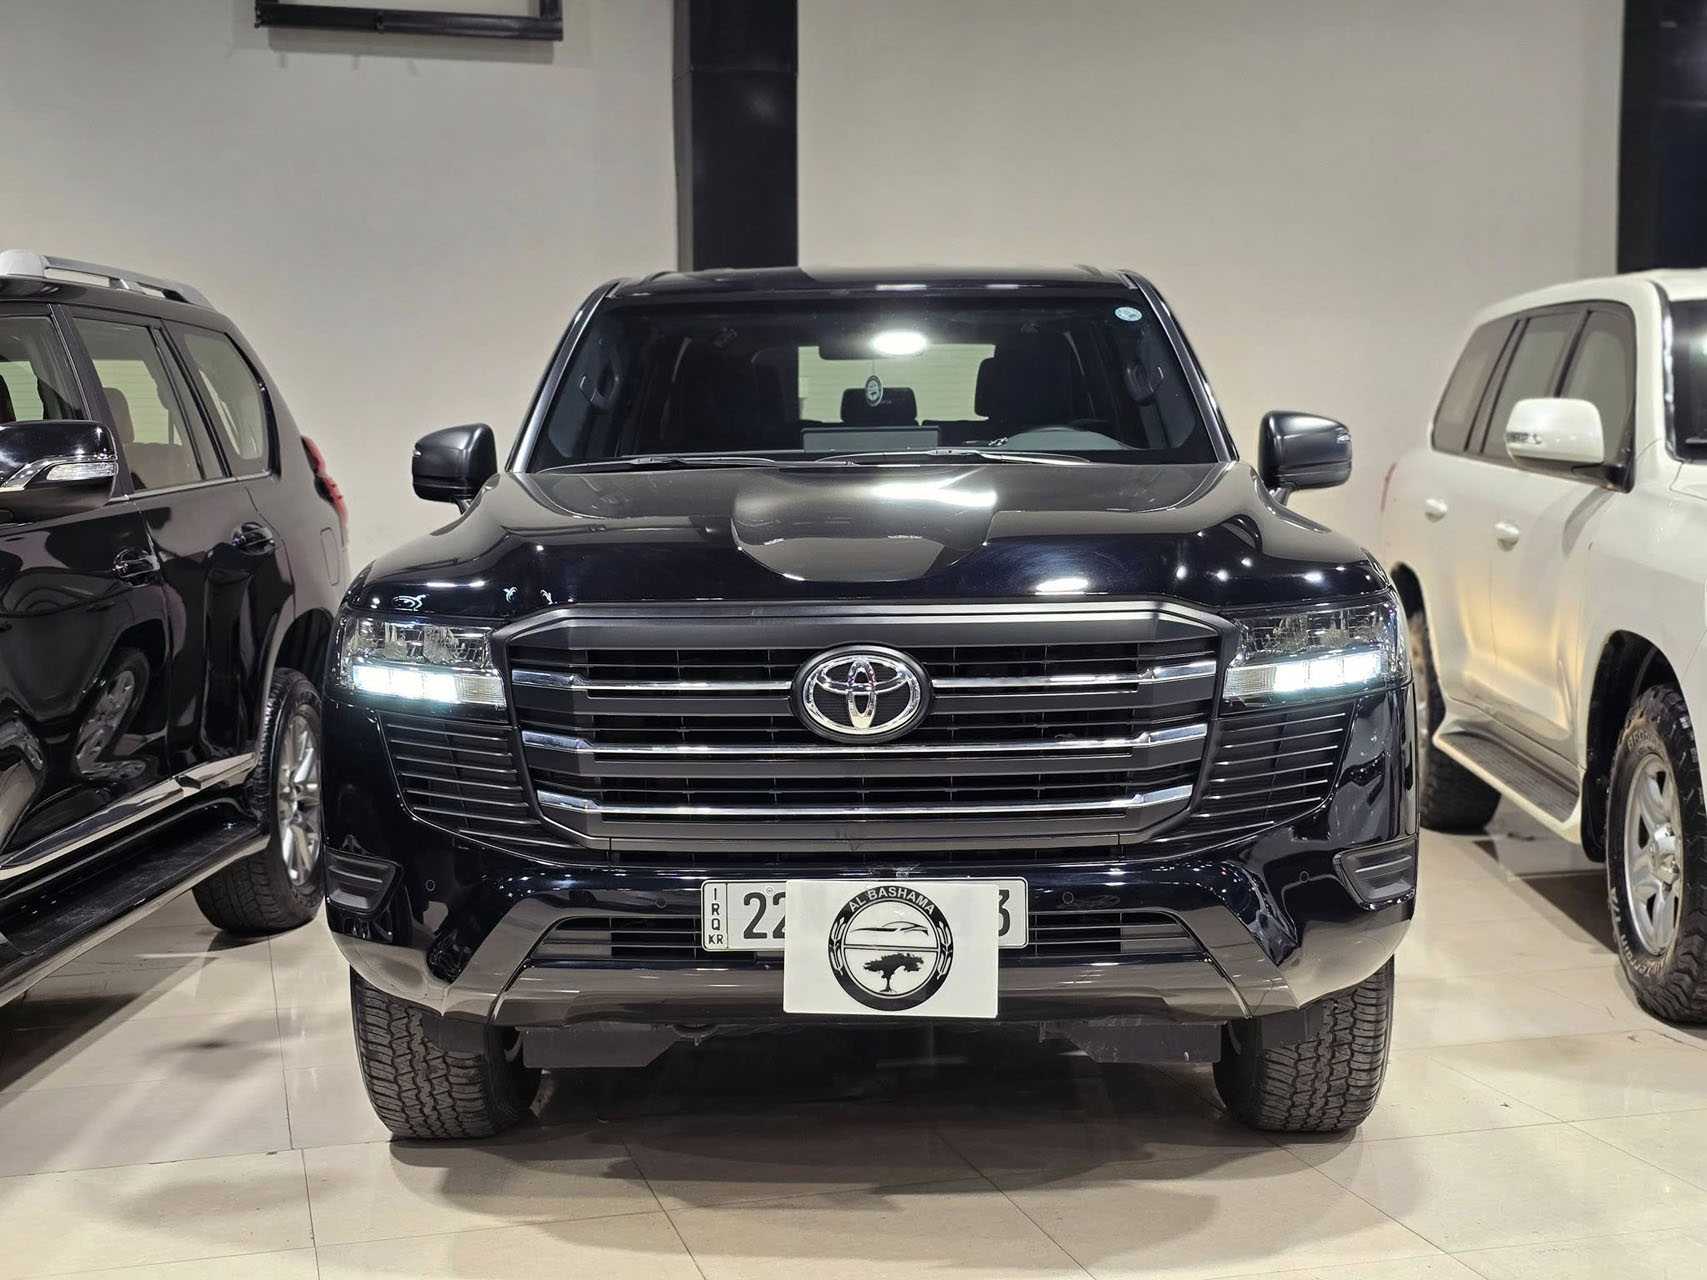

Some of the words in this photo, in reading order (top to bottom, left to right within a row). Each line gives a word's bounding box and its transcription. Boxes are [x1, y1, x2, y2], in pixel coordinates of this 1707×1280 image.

[849, 896, 867, 912] AL
[867, 886, 936, 915] BASHAMA
[708, 934, 724, 945] KR
